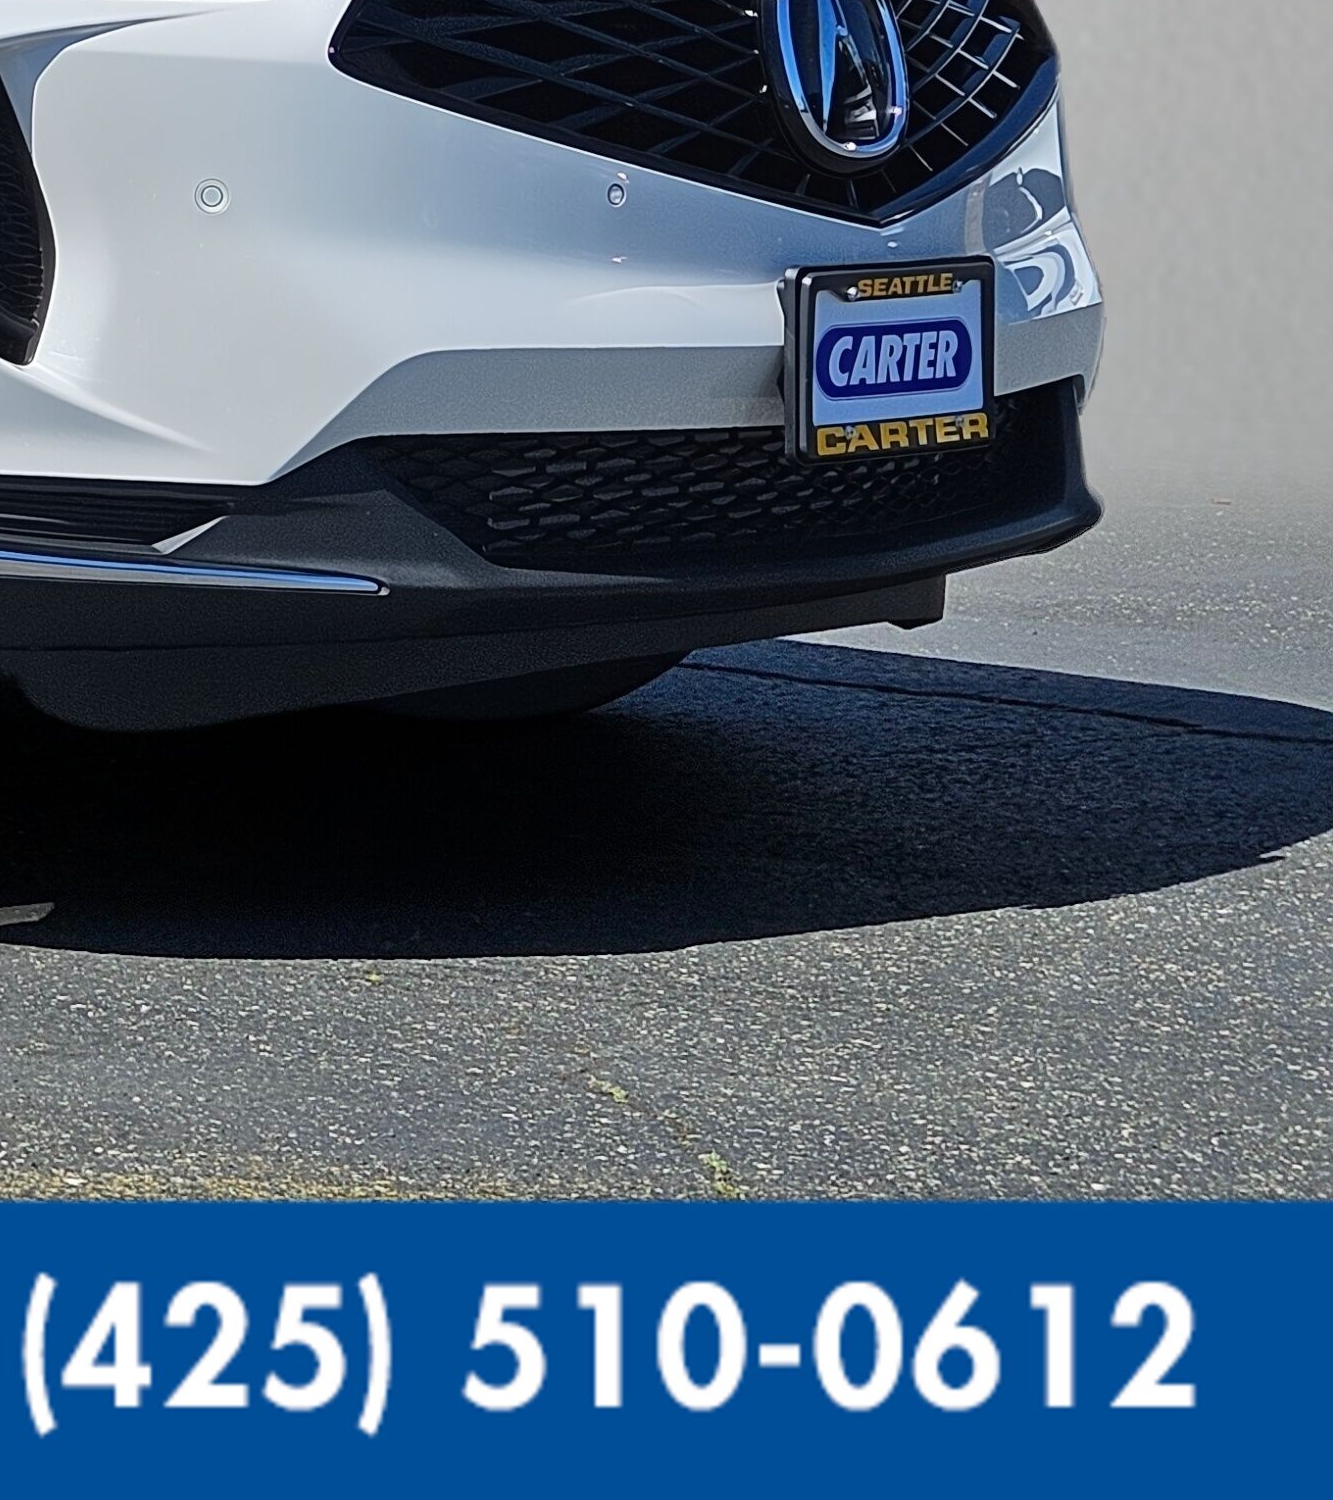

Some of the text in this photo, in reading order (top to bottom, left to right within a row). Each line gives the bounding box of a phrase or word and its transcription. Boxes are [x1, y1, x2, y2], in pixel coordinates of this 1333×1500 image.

[857, 273, 953, 297] SEATTLE
[828, 329, 959, 388] CARTER
[817, 412, 989, 456] CARTER
